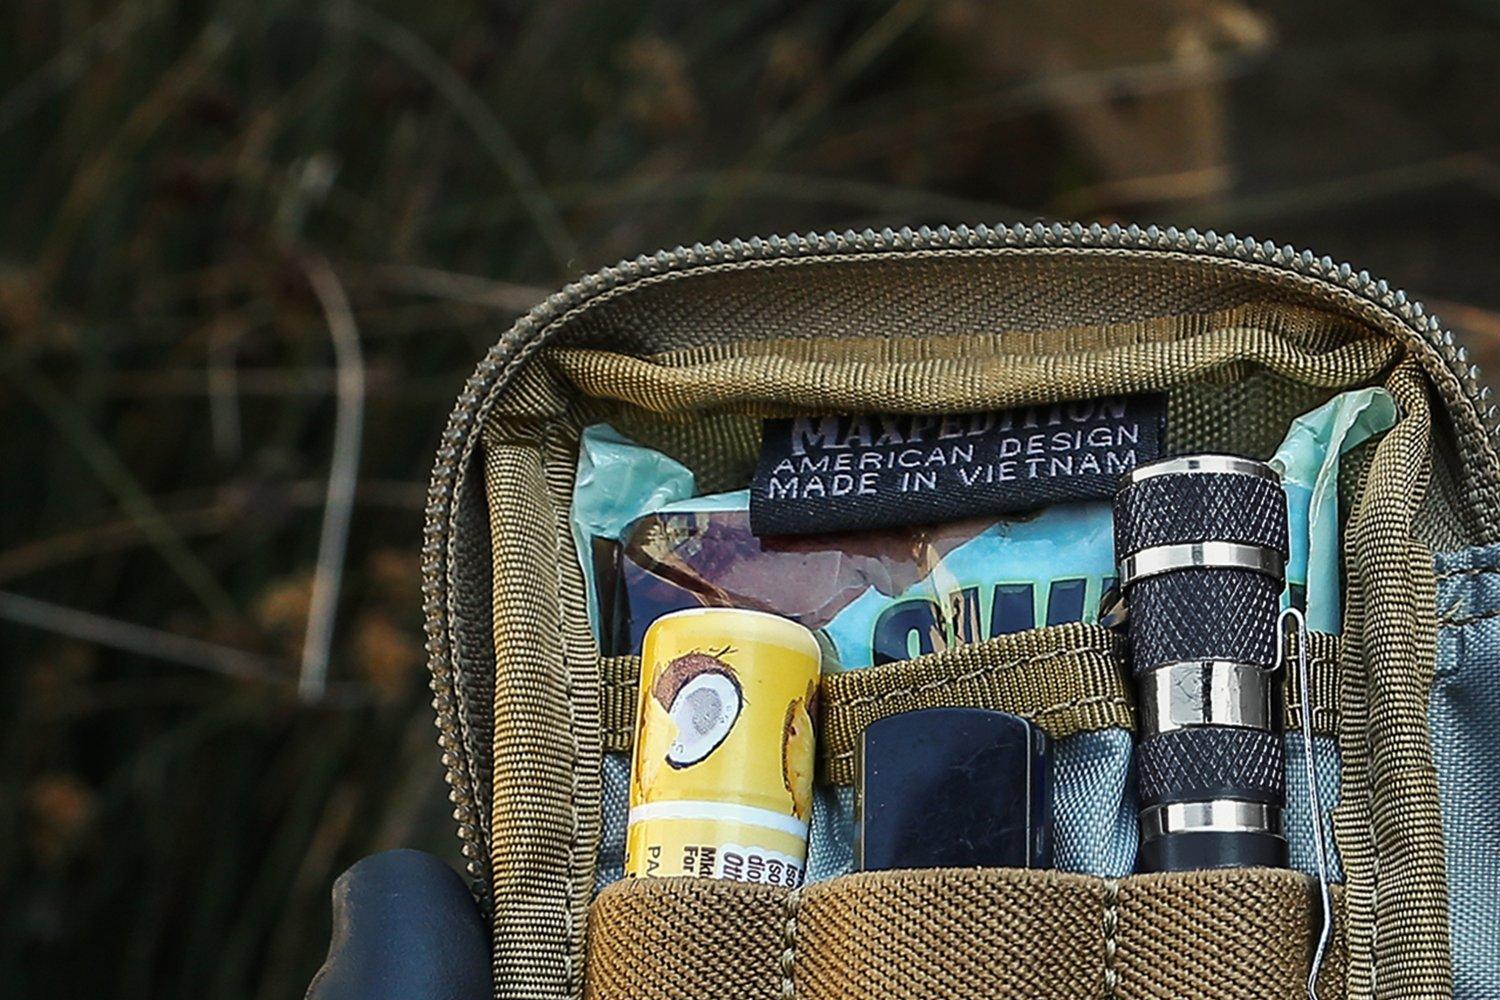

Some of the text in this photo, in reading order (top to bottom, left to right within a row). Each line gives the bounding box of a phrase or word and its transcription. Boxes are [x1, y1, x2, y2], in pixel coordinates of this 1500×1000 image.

[768, 449, 1138, 500] MADE IN VIETNAM
[772, 424, 1140, 476] AMERICAN DESIGN
[682, 846, 698, 873] For
